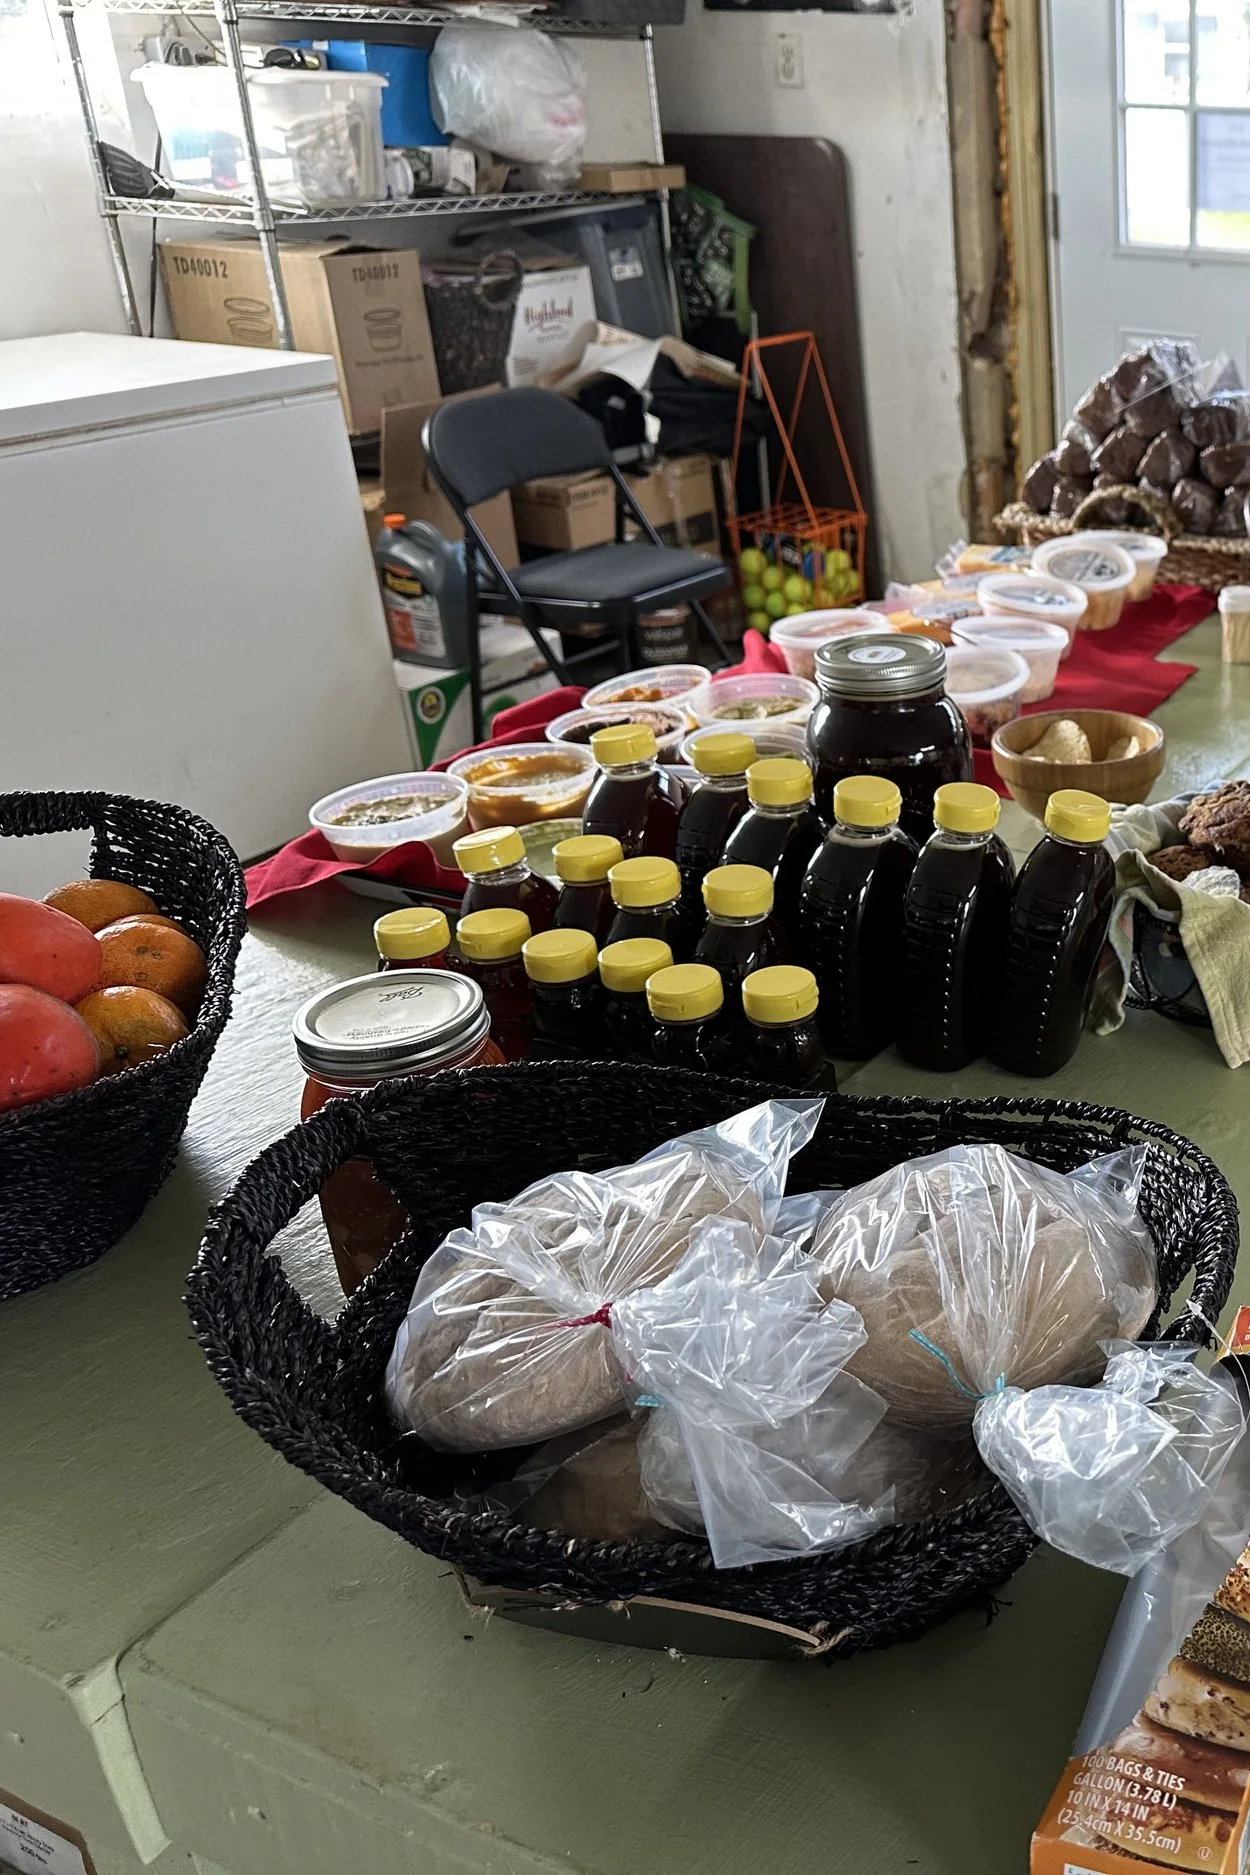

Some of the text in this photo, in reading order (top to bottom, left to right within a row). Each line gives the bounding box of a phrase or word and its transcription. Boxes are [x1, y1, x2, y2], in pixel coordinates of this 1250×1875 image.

[172, 255, 229, 279] TD40012
[351, 263, 400, 283] TD40012
[378, 986, 424, 1003] Ball
[1081, 1754, 1186, 1791] 100 BAGS & TIES
[1066, 1789, 1150, 1822] 10 IN X 14 IN
[1073, 1771, 1177, 1811] GALLON (3.78 L)
[1057, 1807, 1182, 1854] (25.4cm X 35.5cm)
